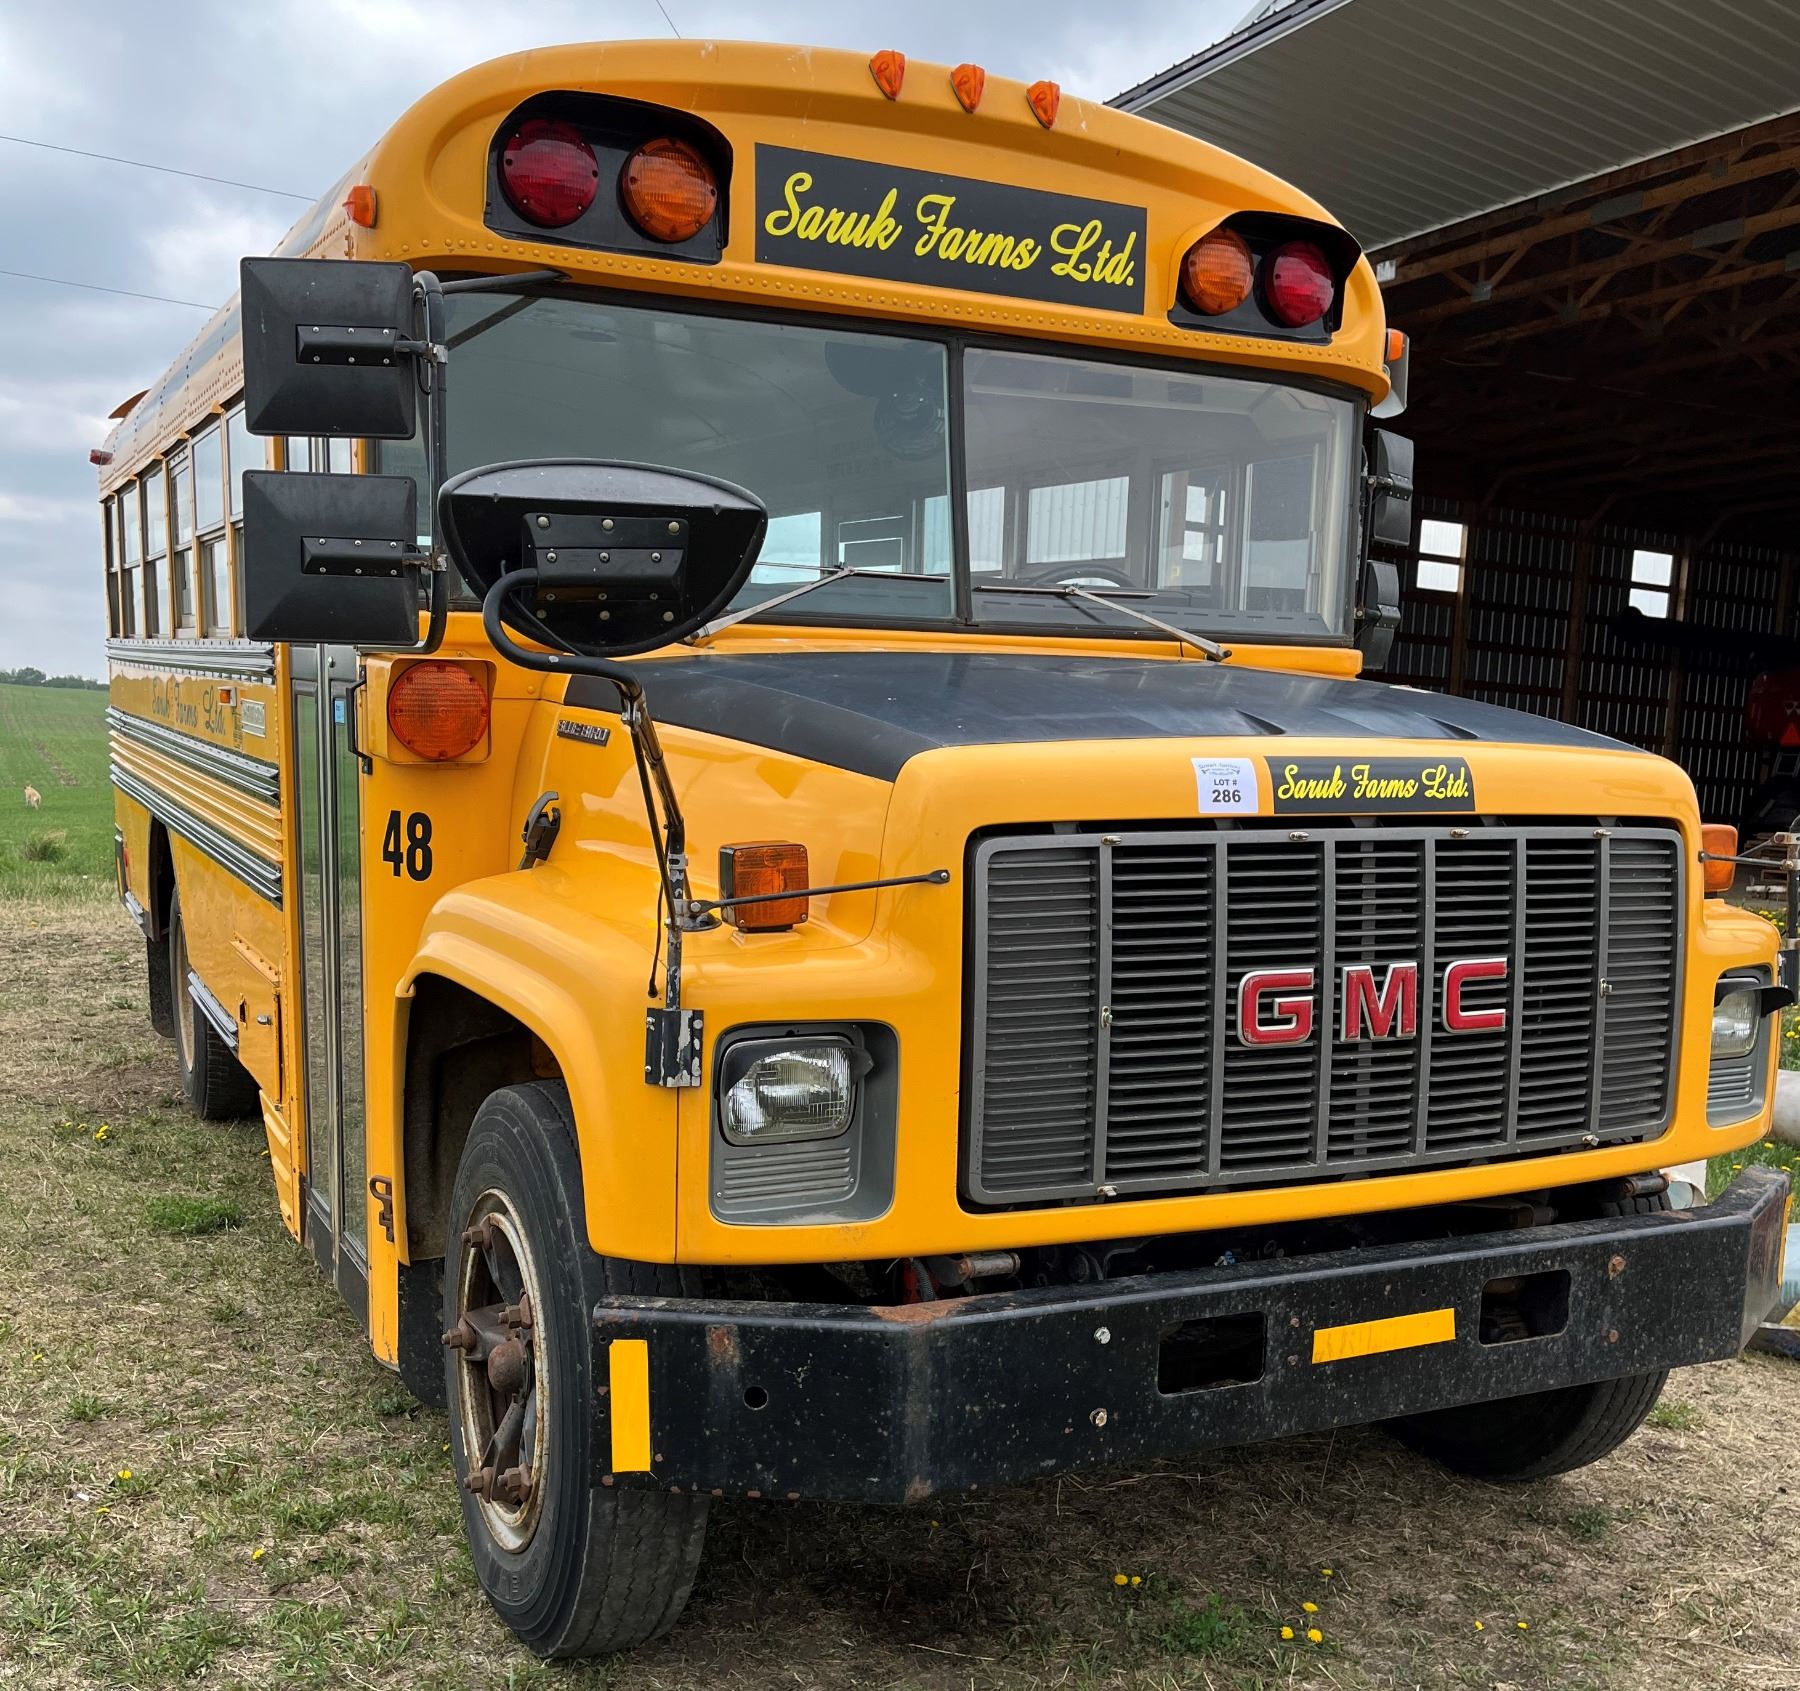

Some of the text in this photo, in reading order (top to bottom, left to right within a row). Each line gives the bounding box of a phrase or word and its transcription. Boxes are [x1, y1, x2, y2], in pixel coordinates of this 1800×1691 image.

[764, 172, 1137, 287] Saruk Farms Ltd.
[1212, 789, 1241, 803] 286
[1213, 778, 1238, 787] LOT #
[1277, 764, 1469, 800] Saruk Farms Ltd.
[382, 809, 433, 882] 48
[1236, 956, 1508, 1048] GMC
